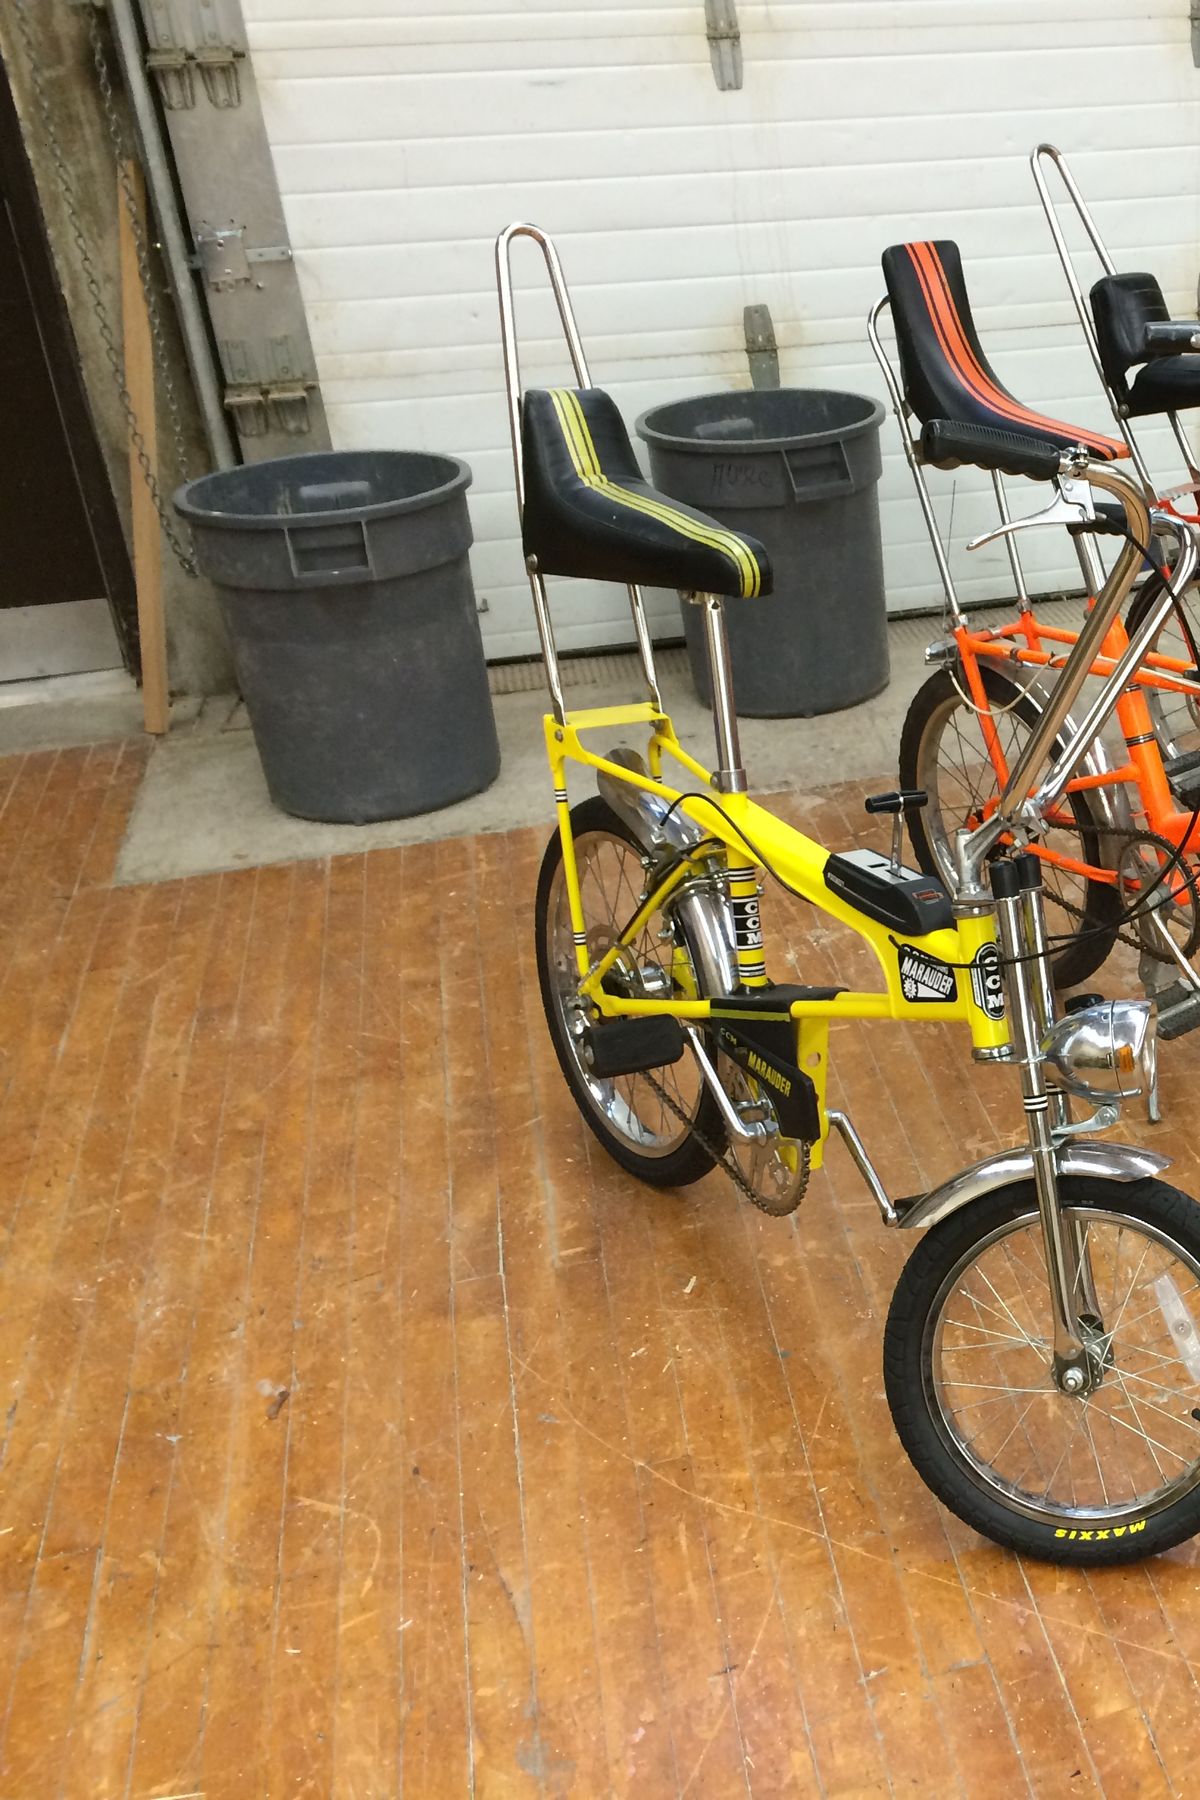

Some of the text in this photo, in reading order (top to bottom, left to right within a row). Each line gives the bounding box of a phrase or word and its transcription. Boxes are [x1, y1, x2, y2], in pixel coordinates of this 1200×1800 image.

[744, 901, 762, 945] CCM
[901, 956, 954, 995] MARAUDER
[747, 1050, 792, 1098] MARAUDER
[1054, 1520, 1147, 1541] MAXXIS
